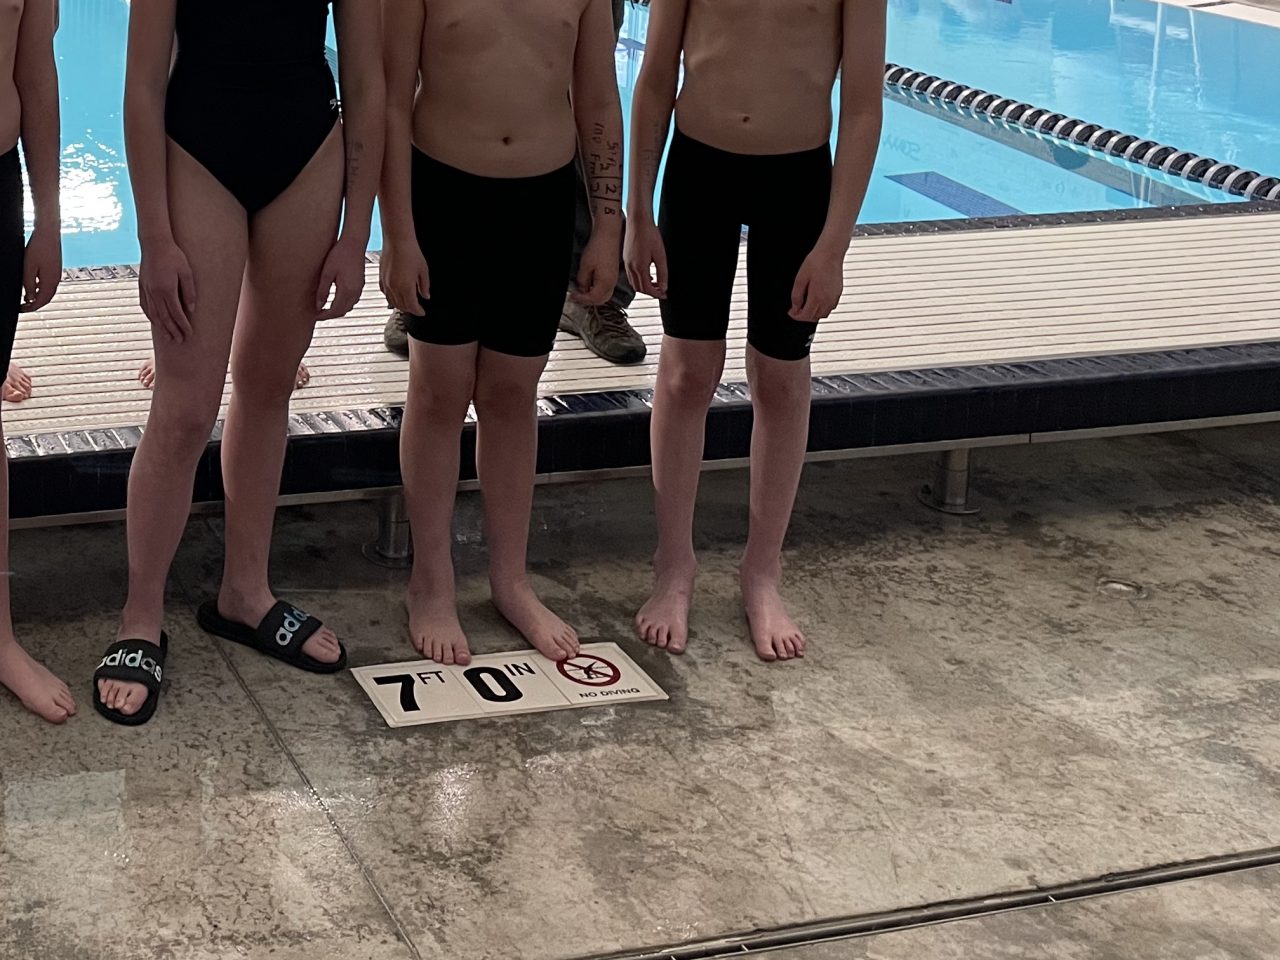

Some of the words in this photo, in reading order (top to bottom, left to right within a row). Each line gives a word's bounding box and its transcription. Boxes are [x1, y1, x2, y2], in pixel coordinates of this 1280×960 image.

[373, 673, 421, 712] 7
[416, 671, 447, 685] FT
[463, 666, 523, 703] 0
[504, 662, 536, 677] IN
[579, 690, 598, 699] NO
[600, 687, 640, 697] DIVING
